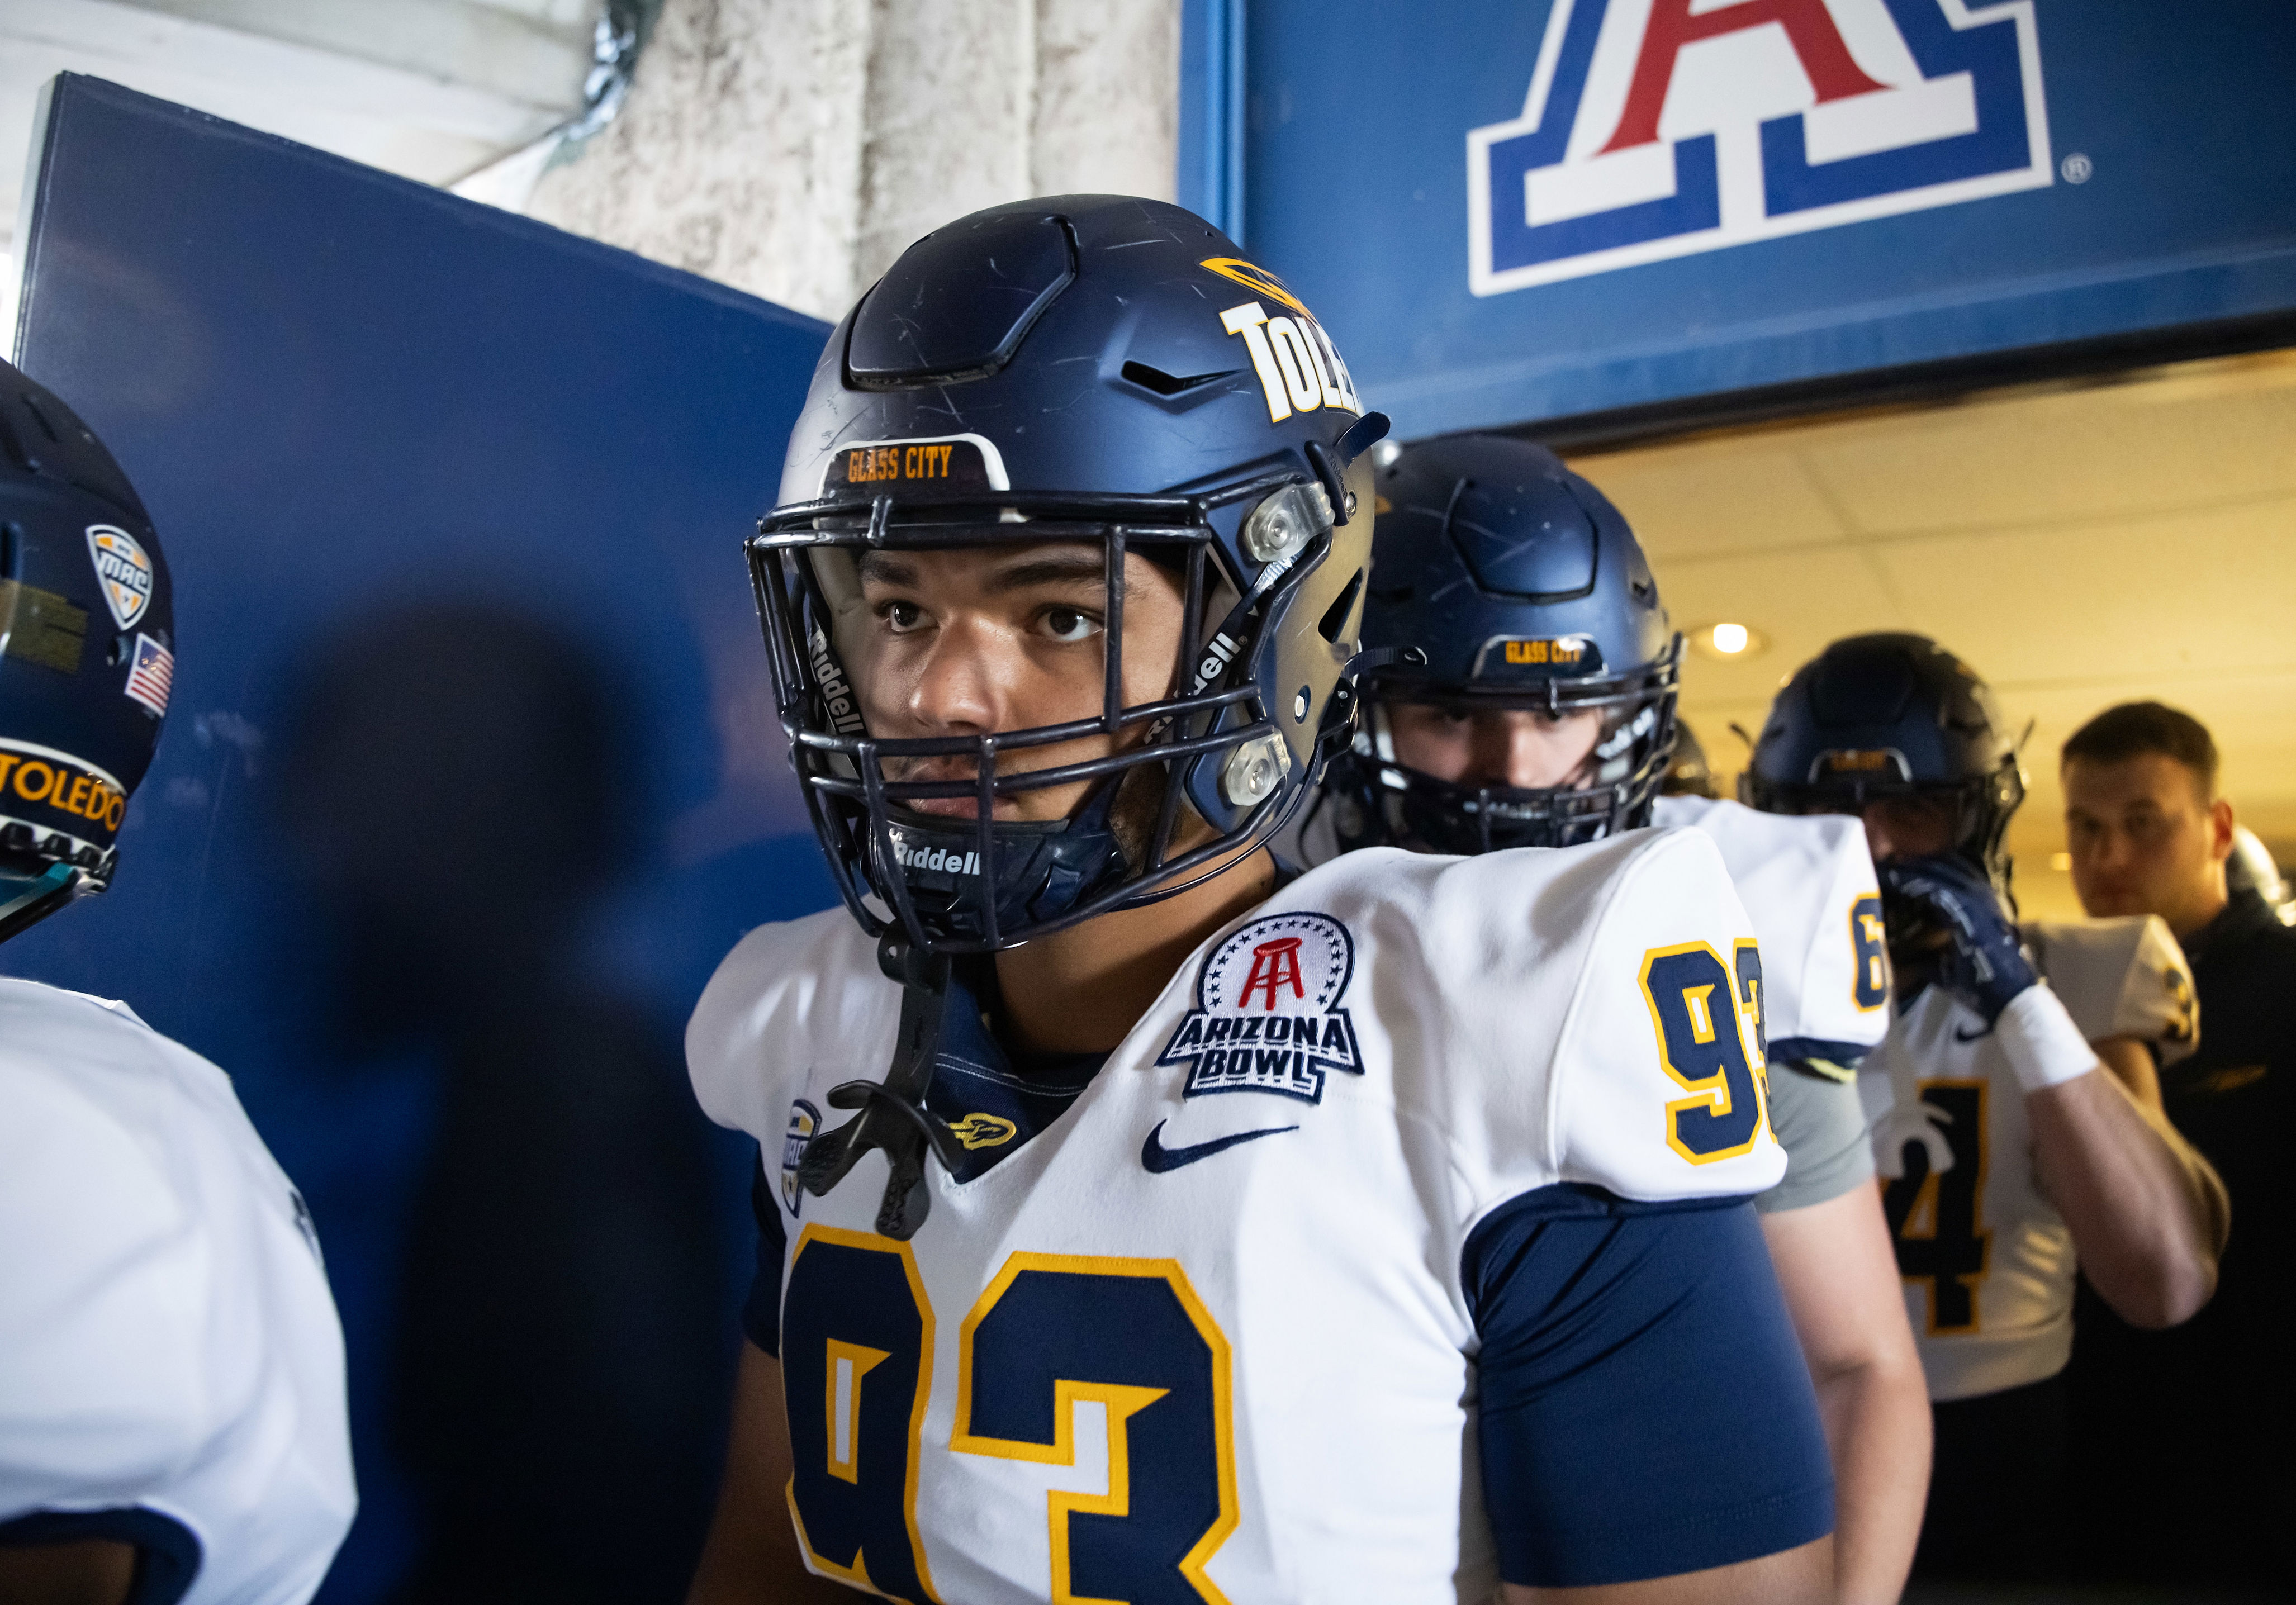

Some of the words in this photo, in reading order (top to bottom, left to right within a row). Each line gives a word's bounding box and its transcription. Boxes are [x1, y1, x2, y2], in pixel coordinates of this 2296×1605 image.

[1219, 301, 1365, 423] TOLE
[848, 448, 899, 483] GLASS
[905, 445, 953, 479] CITY
[97, 550, 150, 596] MAC
[810, 629, 864, 734] Riddell
[0, 754, 124, 832] TOLEDO
[894, 842, 980, 875] Riddell
[1177, 1017, 1349, 1053] ARIZONA
[1198, 1048, 1312, 1082] BOWL
[781, 1222, 1241, 1605] 93
